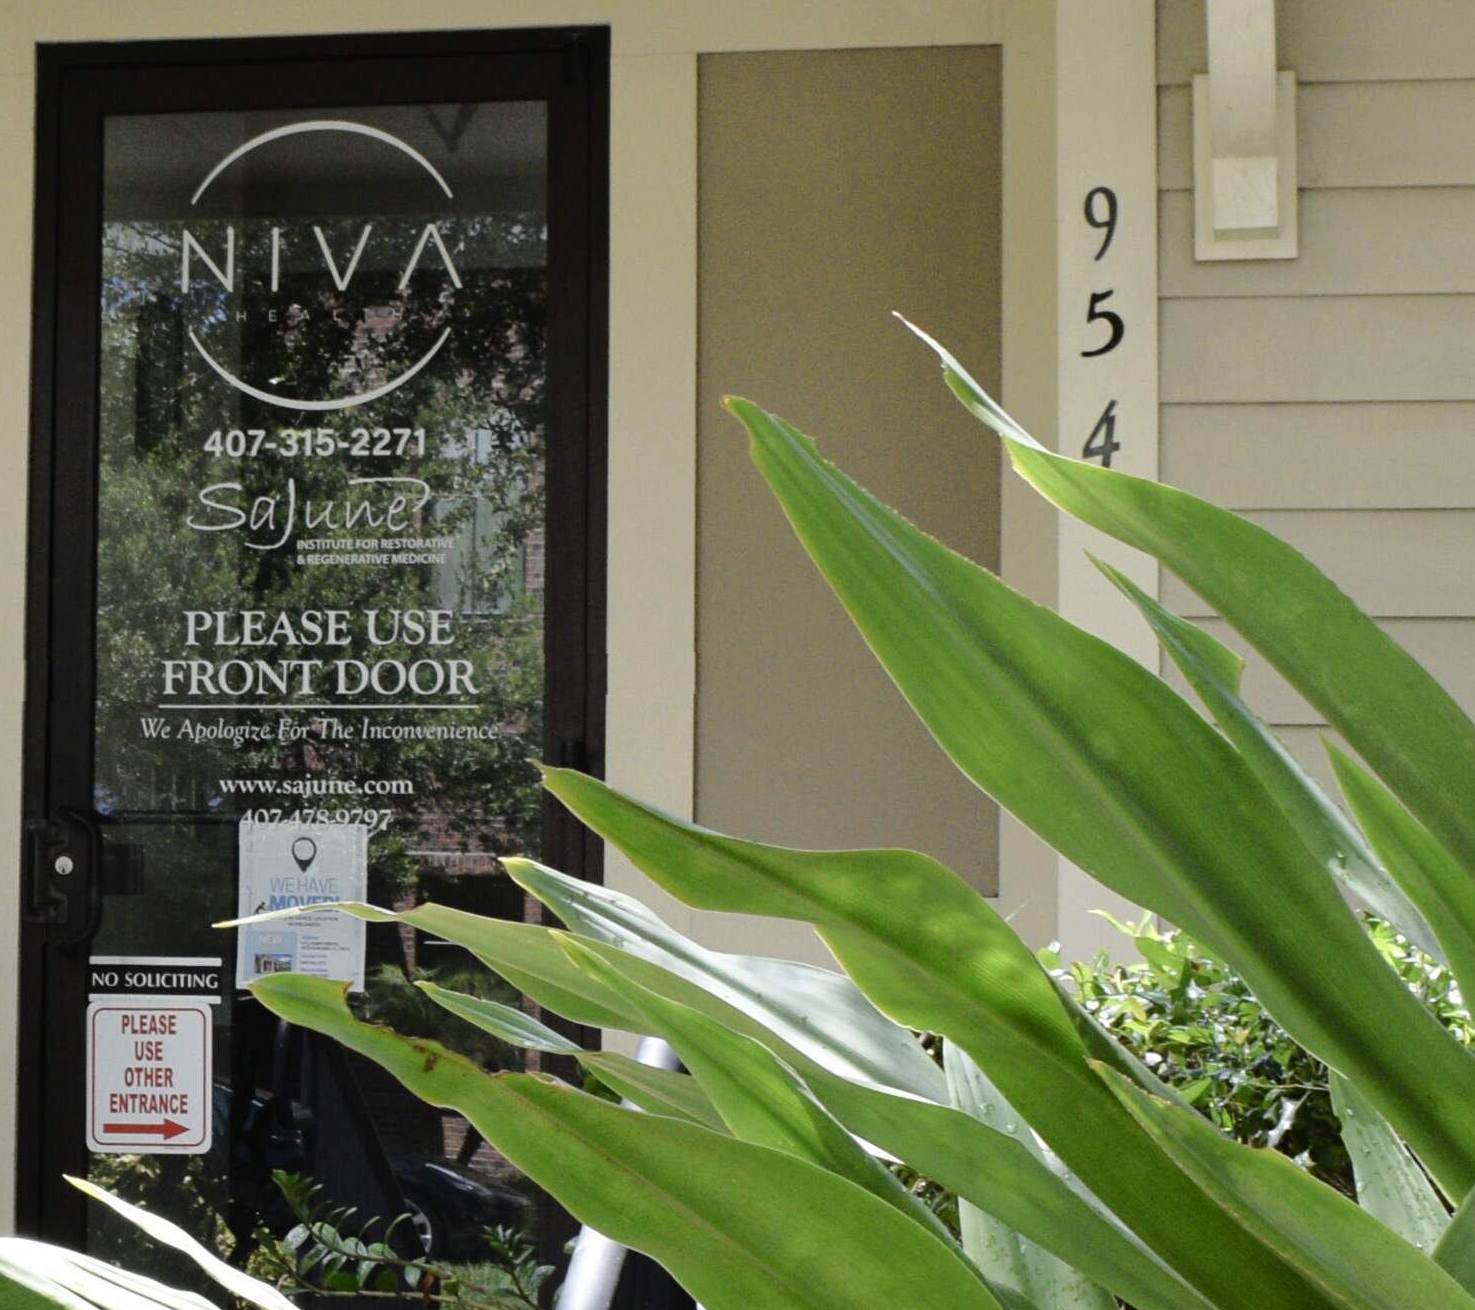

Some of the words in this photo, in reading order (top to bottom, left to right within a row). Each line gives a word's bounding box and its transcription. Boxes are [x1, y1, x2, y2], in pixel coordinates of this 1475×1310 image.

[1081, 186, 1125, 469] 954
[203, 428, 427, 458] 407-315-2271
[296, 539, 353, 551] INSTITUTE
[355, 539, 379, 550] FOR
[380, 538, 454, 550] RESTORATIVE
[296, 554, 306, 565] &
[307, 554, 389, 566] REGENERATIVE
[390, 553, 447, 565] MEDICINE
[183, 610, 352, 646] PLEASE
[365, 609, 456, 646] USE
[161, 659, 323, 696] FRONT
[334, 659, 480, 696] DOOR
[140, 718, 171, 740] We
[177, 718, 270, 746] Apologize
[278, 718, 310, 740] For
[318, 718, 354, 740] The
[361, 718, 499, 741] Inconvenience
[219, 774, 414, 797] www.sajune.com
[240, 808, 393, 832] 407-478-9797
[269, 876, 294, 893] WE
[297, 877, 339, 894] HAVE
[91, 972, 119, 987] NO
[124, 972, 219, 989] SOLICITING
[121, 1014, 177, 1035] PLEASE
[134, 1041, 163, 1061] USE
[124, 1067, 173, 1088] OTHER
[109, 1093, 188, 1114] ENTRANCE
